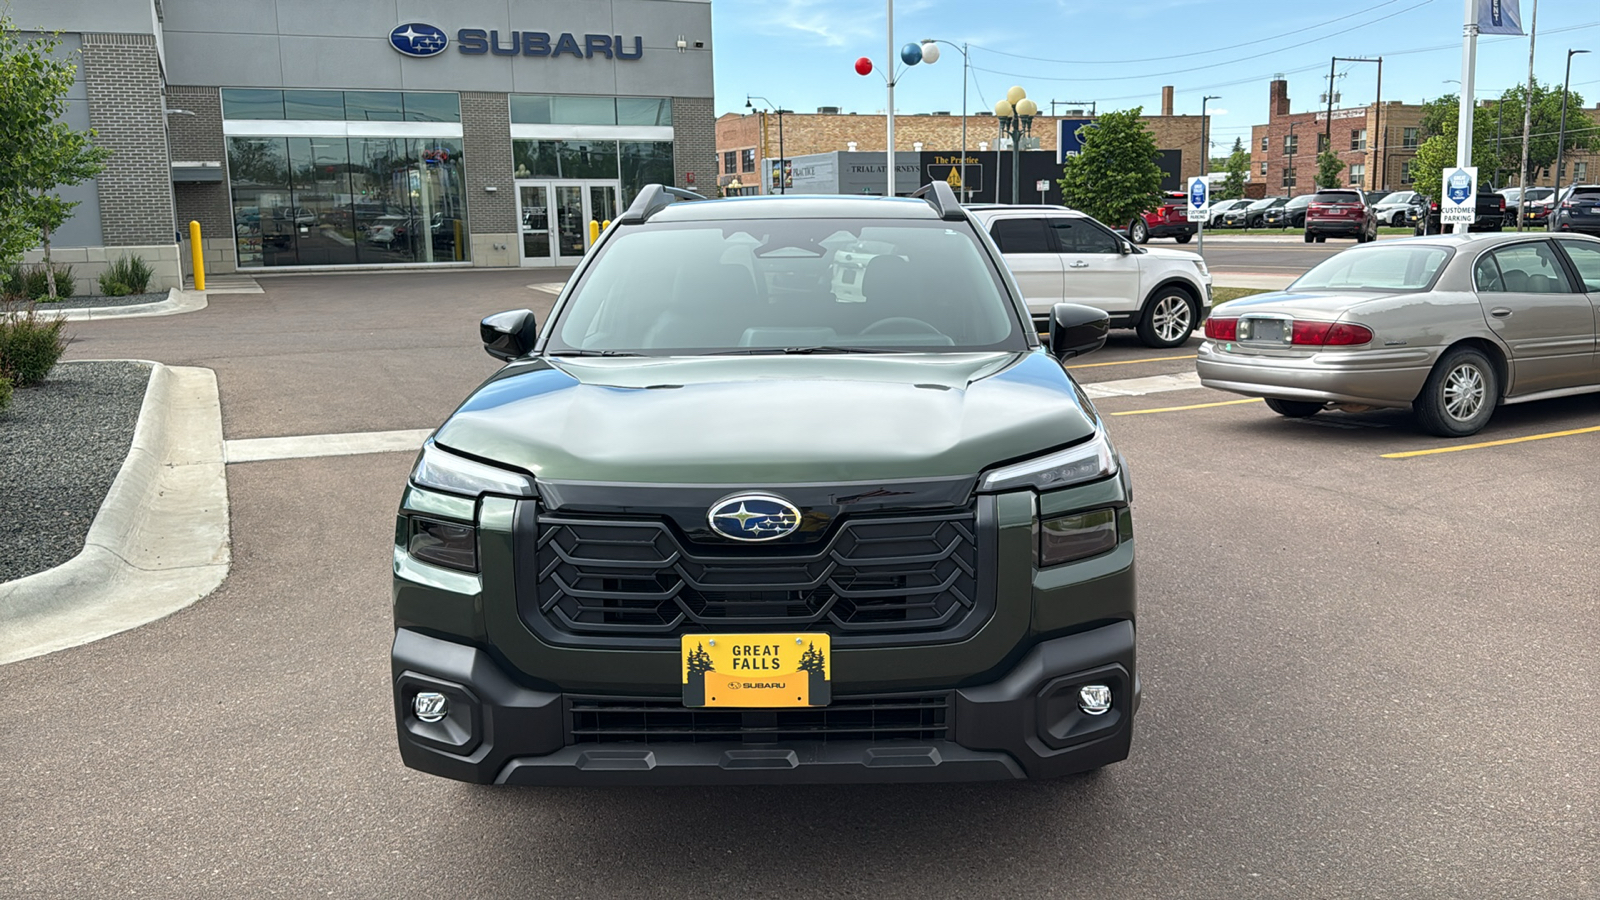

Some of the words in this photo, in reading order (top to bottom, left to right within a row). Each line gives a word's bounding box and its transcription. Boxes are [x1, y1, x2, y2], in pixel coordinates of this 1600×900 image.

[457, 28, 643, 60] SUBARU
[934, 156, 949, 164] The
[950, 156, 979, 164] Pratice
[851, 165, 875, 173] TRIAL
[876, 165, 920, 173] ATRNEYS
[732, 645, 781, 656] GREAT
[732, 658, 781, 670] FALLS
